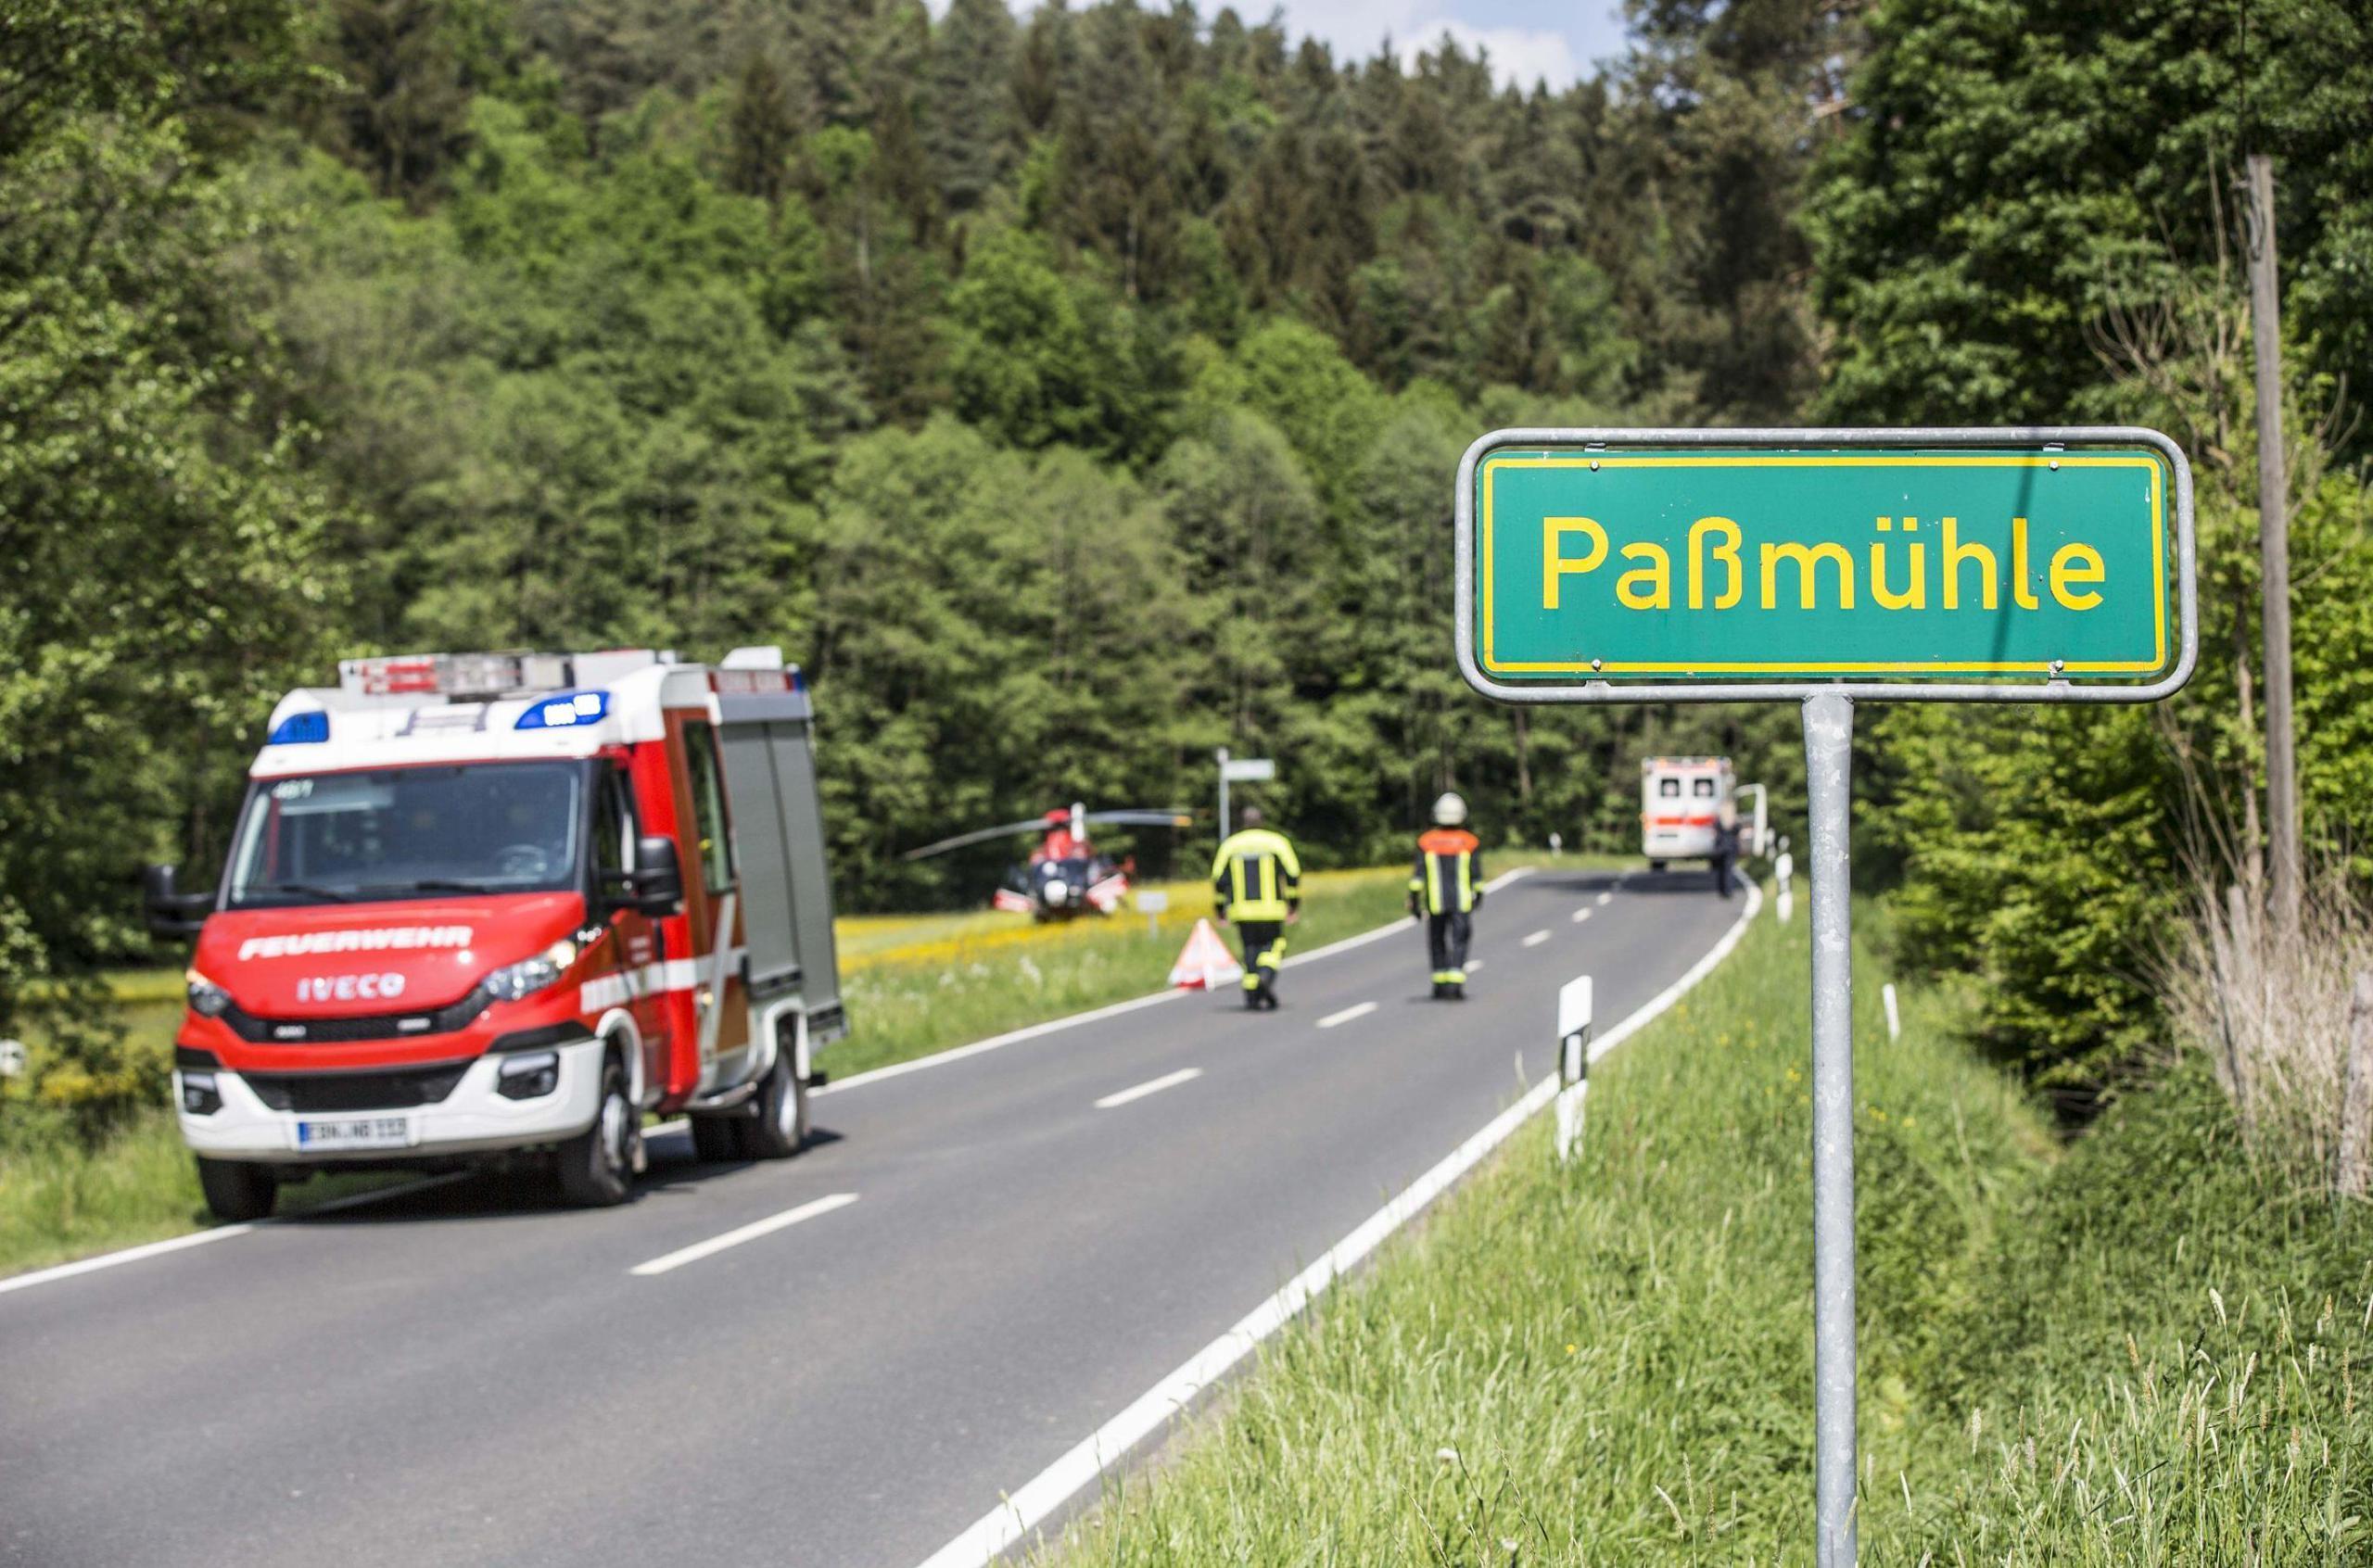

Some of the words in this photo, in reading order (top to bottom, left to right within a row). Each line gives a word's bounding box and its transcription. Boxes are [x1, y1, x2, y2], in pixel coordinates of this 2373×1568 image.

[1542, 516, 2105, 611] Paßmühle
[238, 926, 473, 961] FEUERWEHR
[298, 973, 405, 1002] IVECO
